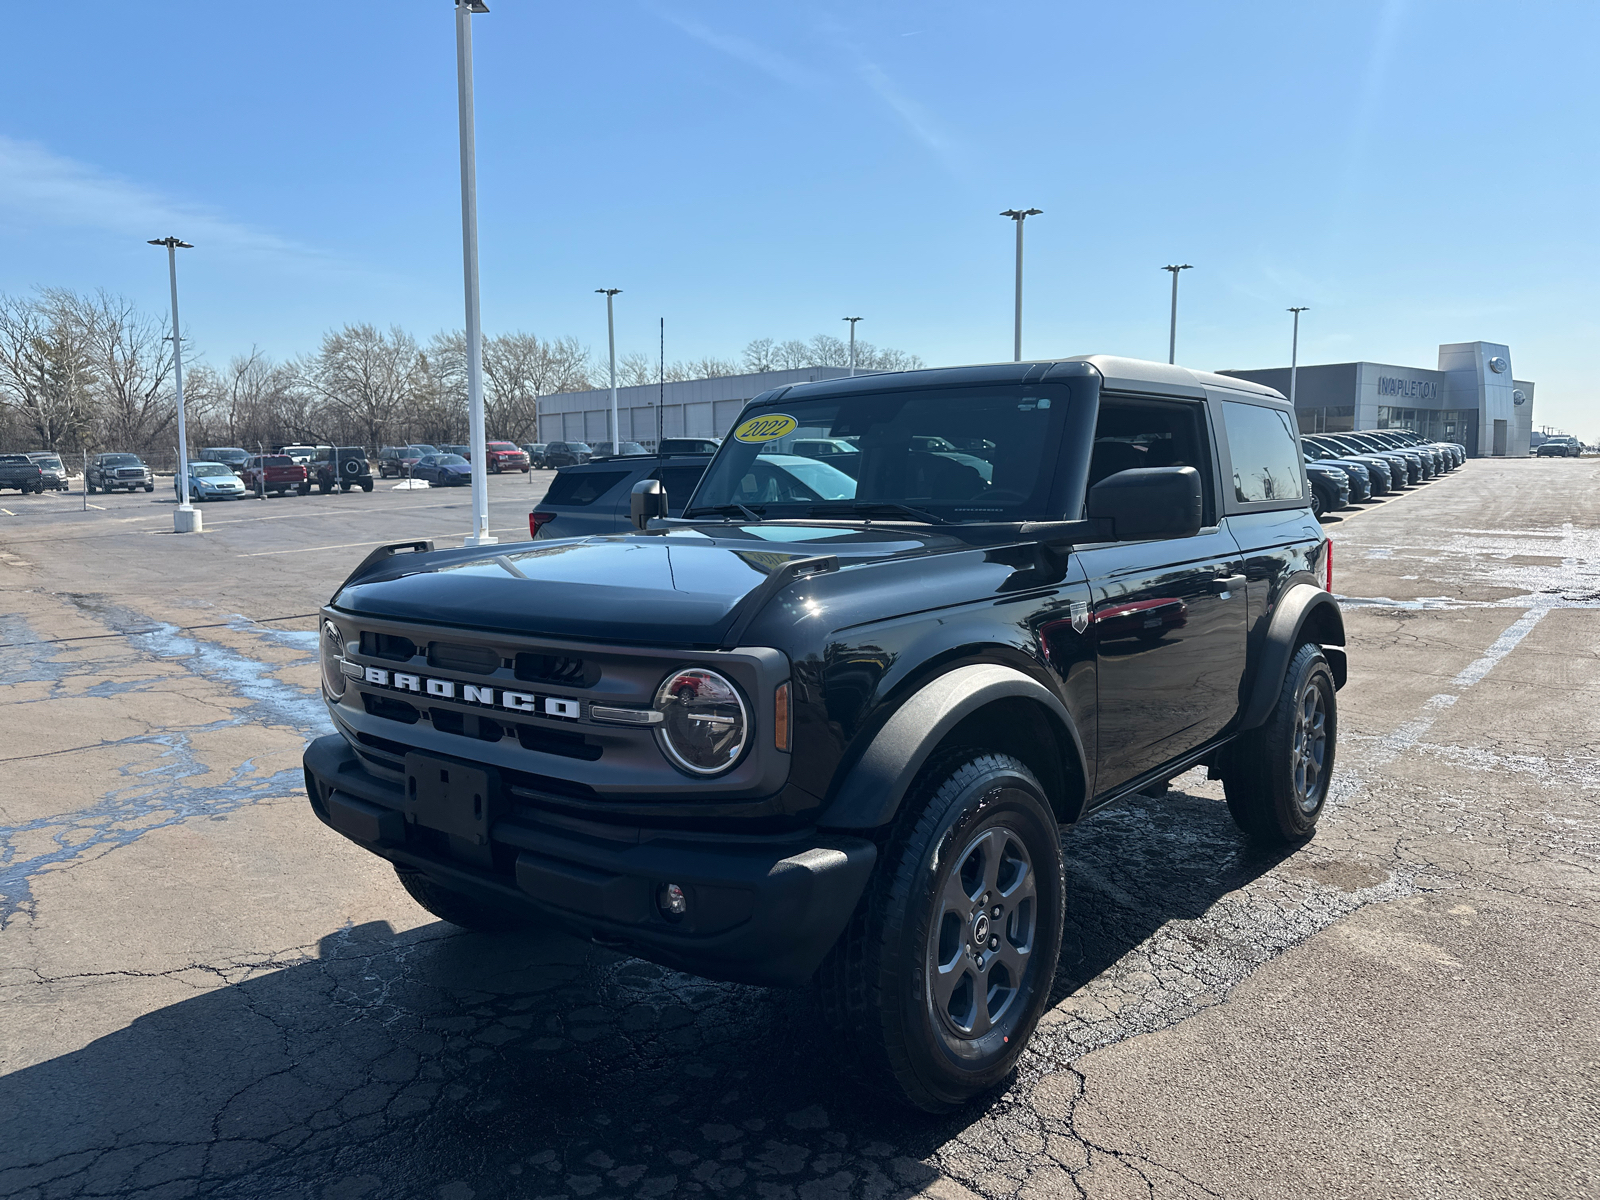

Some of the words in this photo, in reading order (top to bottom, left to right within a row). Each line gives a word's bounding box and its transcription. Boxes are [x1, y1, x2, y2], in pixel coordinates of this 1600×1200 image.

[1379, 377, 1437, 399] NAPLETON
[740, 420, 789, 437] 2022
[365, 666, 581, 719] BRONCO
